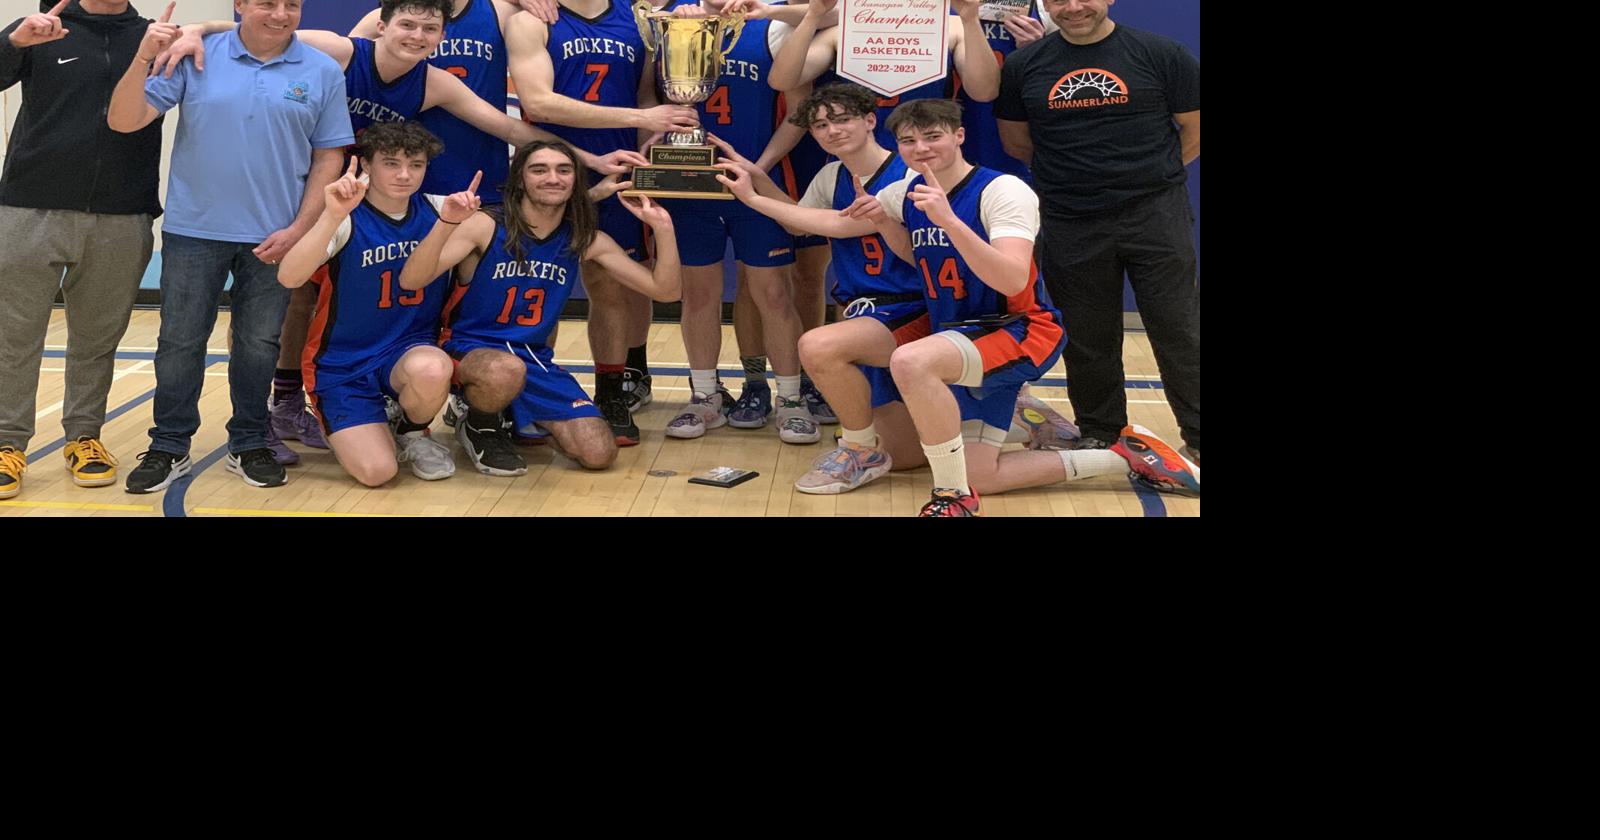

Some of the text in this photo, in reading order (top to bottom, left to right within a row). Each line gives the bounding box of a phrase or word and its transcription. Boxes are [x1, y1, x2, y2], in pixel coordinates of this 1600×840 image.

[907, 0, 938, 11] Valley
[853, 9, 936, 29] Champion
[424, 38, 493, 61] CKETS
[563, 37, 635, 63] ROCKETS
[852, 46, 933, 56] BASKETBALL
[866, 37, 920, 46] AA BOYS
[867, 64, 917, 73] 2022-2023
[585, 64, 609, 101] 7
[705, 85, 732, 125] 4
[1048, 96, 1129, 109] SUMMERLAND
[658, 152, 706, 162] Champions
[911, 226, 949, 251] OCKE
[860, 235, 884, 276] 9
[492, 260, 568, 286] ROCKETS
[919, 257, 968, 300] 14
[496, 286, 546, 326] 13
